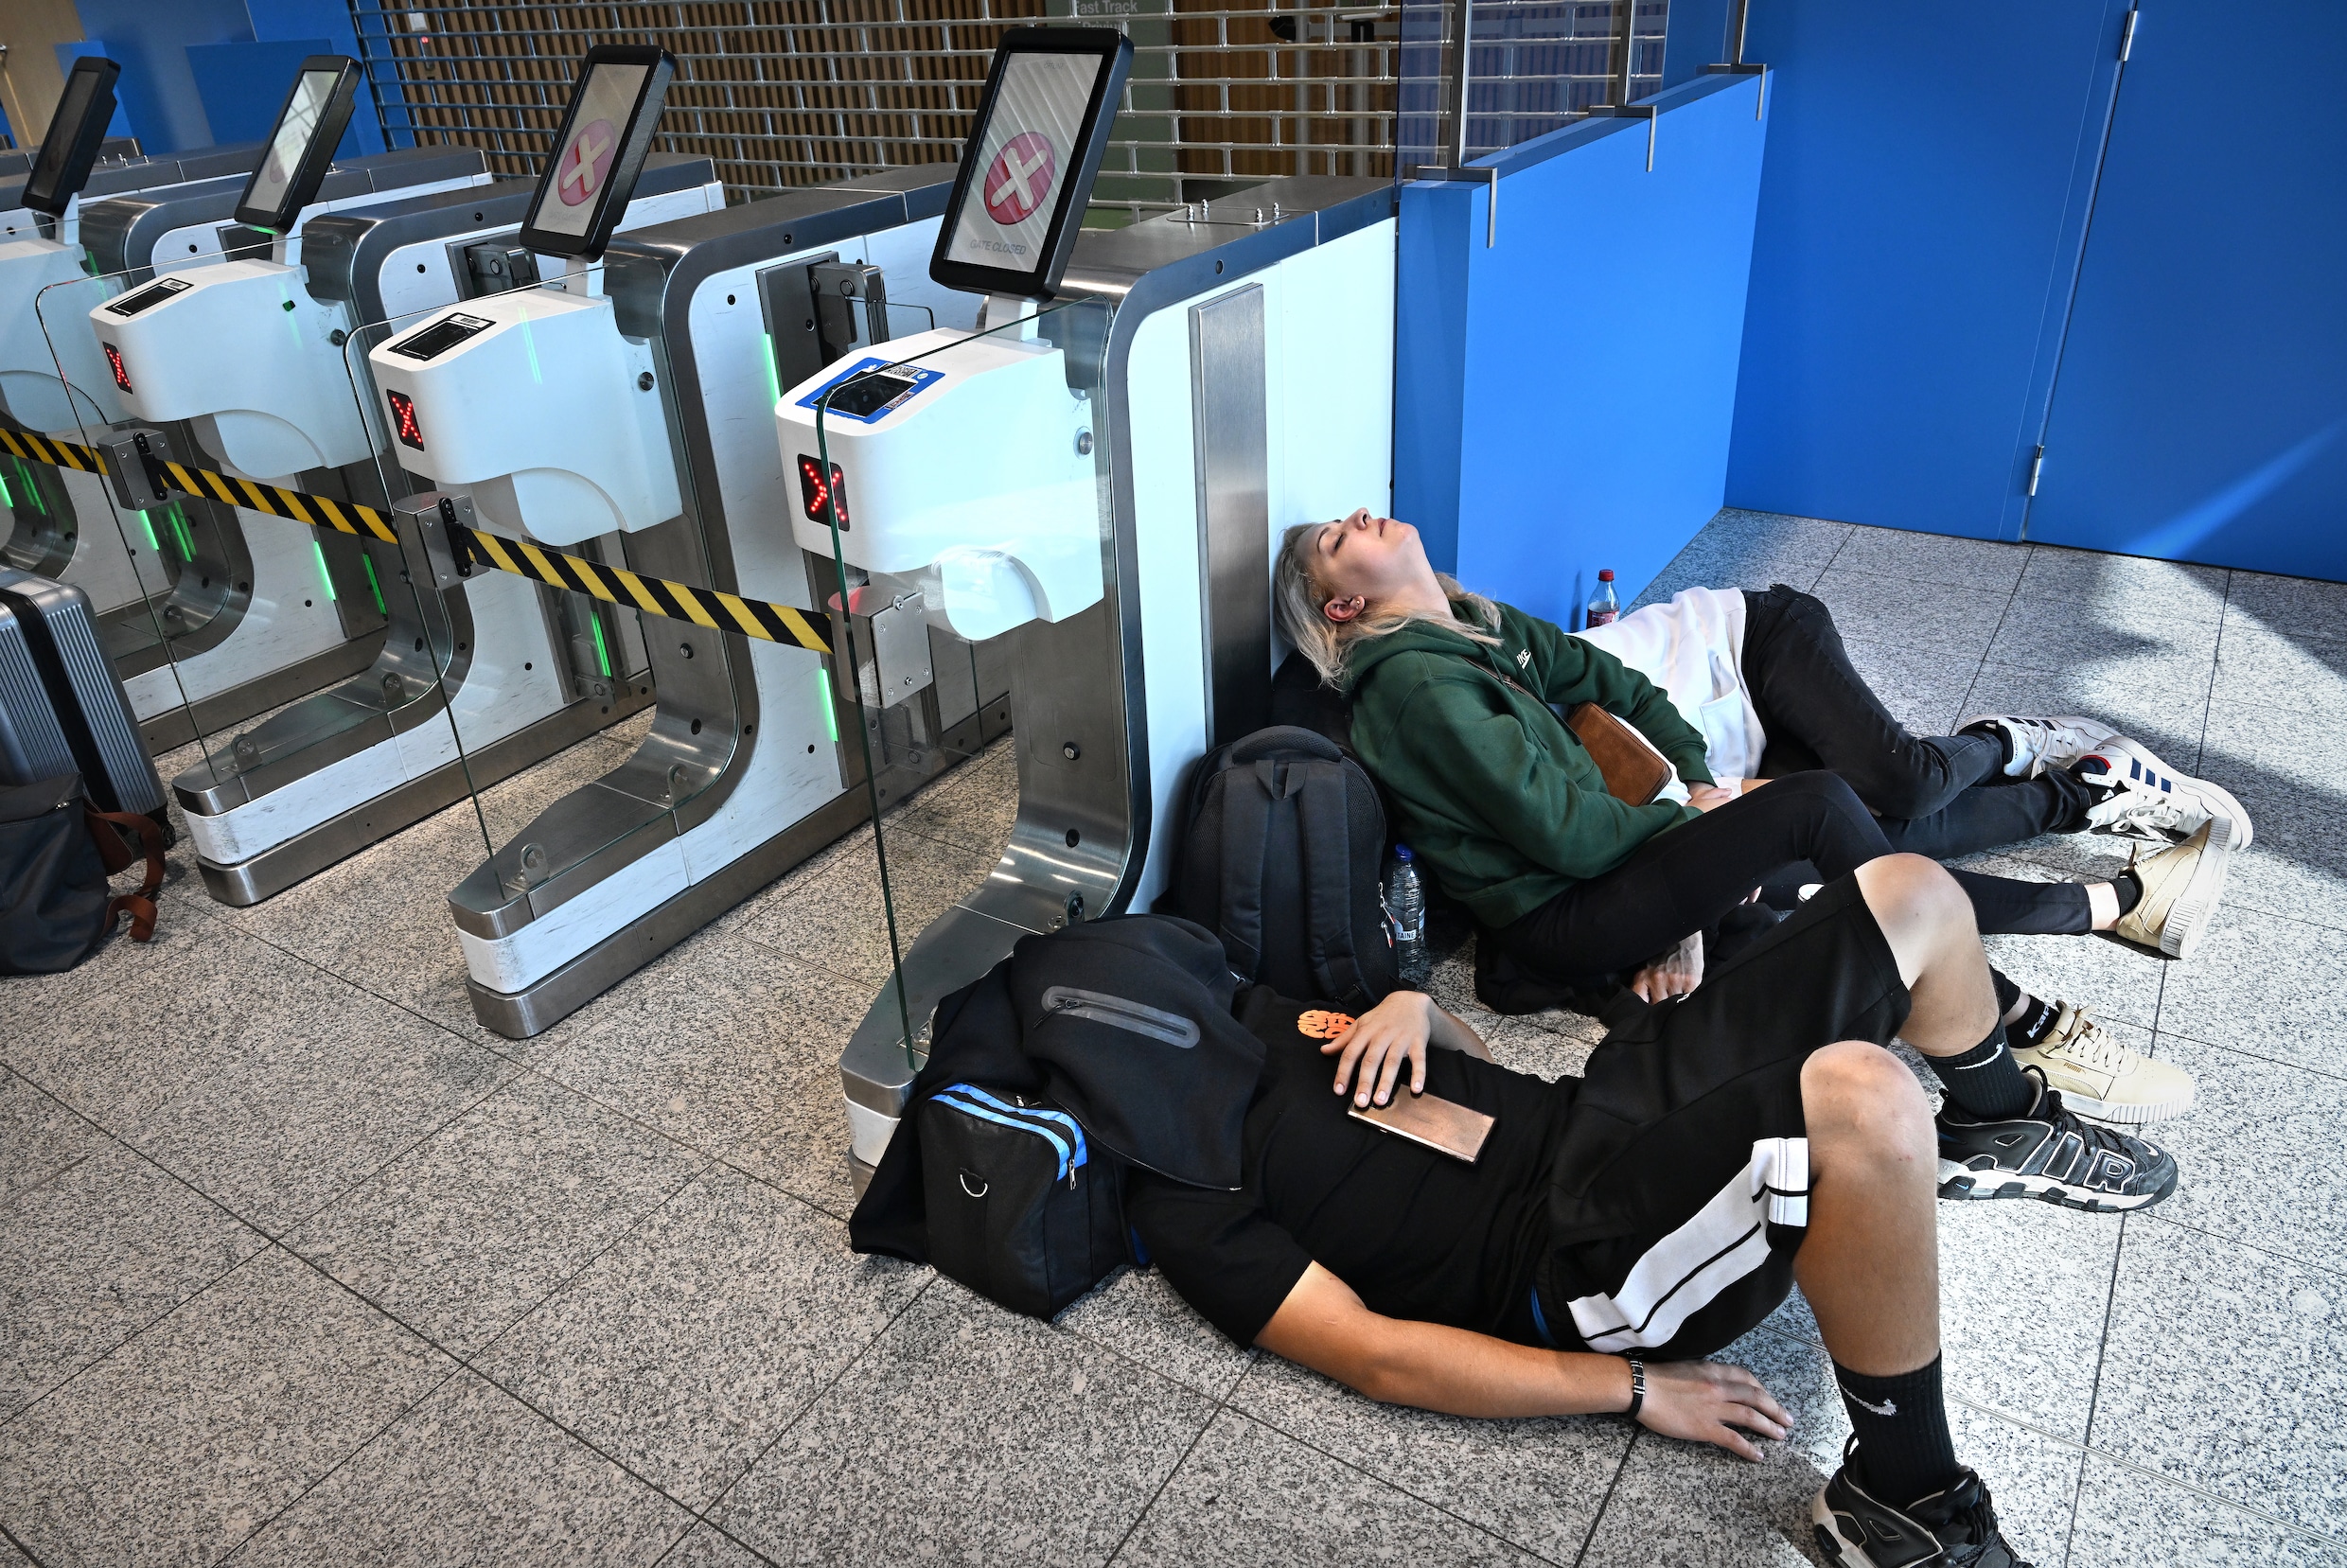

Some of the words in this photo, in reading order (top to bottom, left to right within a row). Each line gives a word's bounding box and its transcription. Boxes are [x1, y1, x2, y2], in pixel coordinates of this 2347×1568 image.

[1075, 0, 1100, 14] ast
[1103, 0, 1138, 13] Track
[970, 238, 991, 251] GATE
[992, 241, 1027, 255] CLOSED
[2064, 1061, 2082, 1073] PUMA
